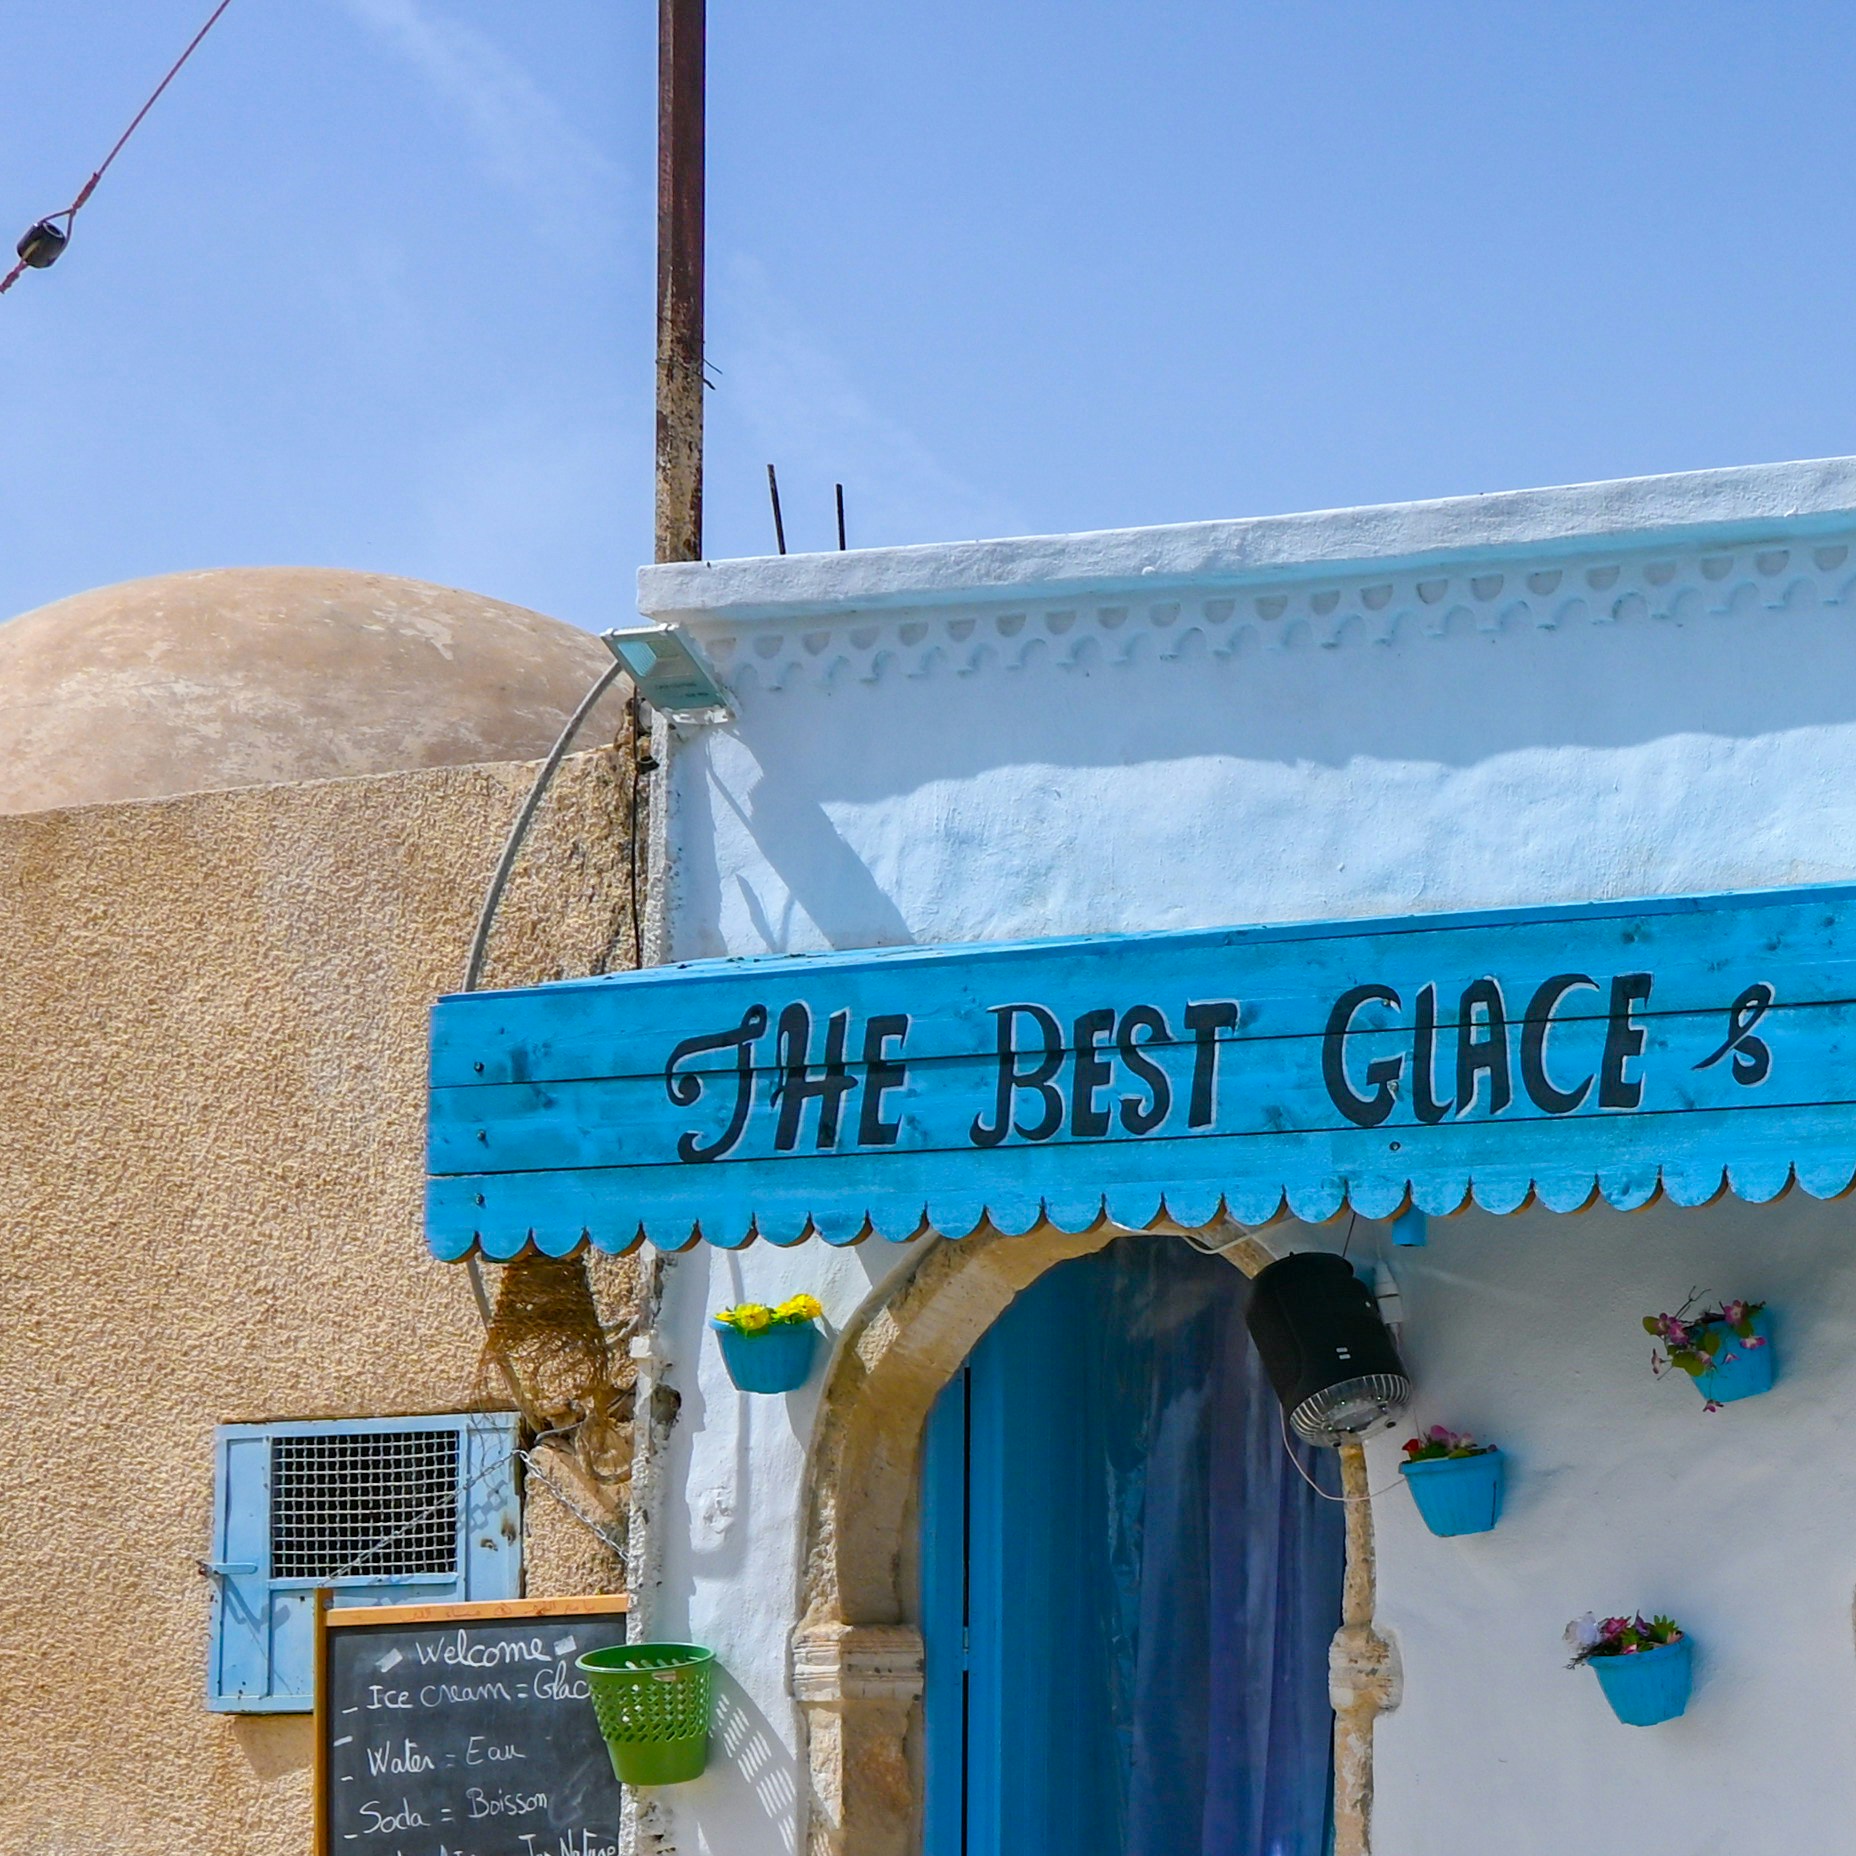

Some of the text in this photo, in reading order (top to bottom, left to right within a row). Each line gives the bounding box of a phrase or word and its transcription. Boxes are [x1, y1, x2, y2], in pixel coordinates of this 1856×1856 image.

[665, 998, 912, 1163] THE
[968, 997, 1241, 1148] BEST
[1321, 970, 1656, 1127] GLACE
[416, 1628, 553, 1668] Welcome
[366, 1684, 414, 1711] Ice
[533, 1660, 592, 1701] Glac
[366, 1738, 436, 1777] Water
[465, 1736, 527, 1766] Eau
[359, 1797, 431, 1835] Soda
[466, 1787, 548, 1819] Boisson
